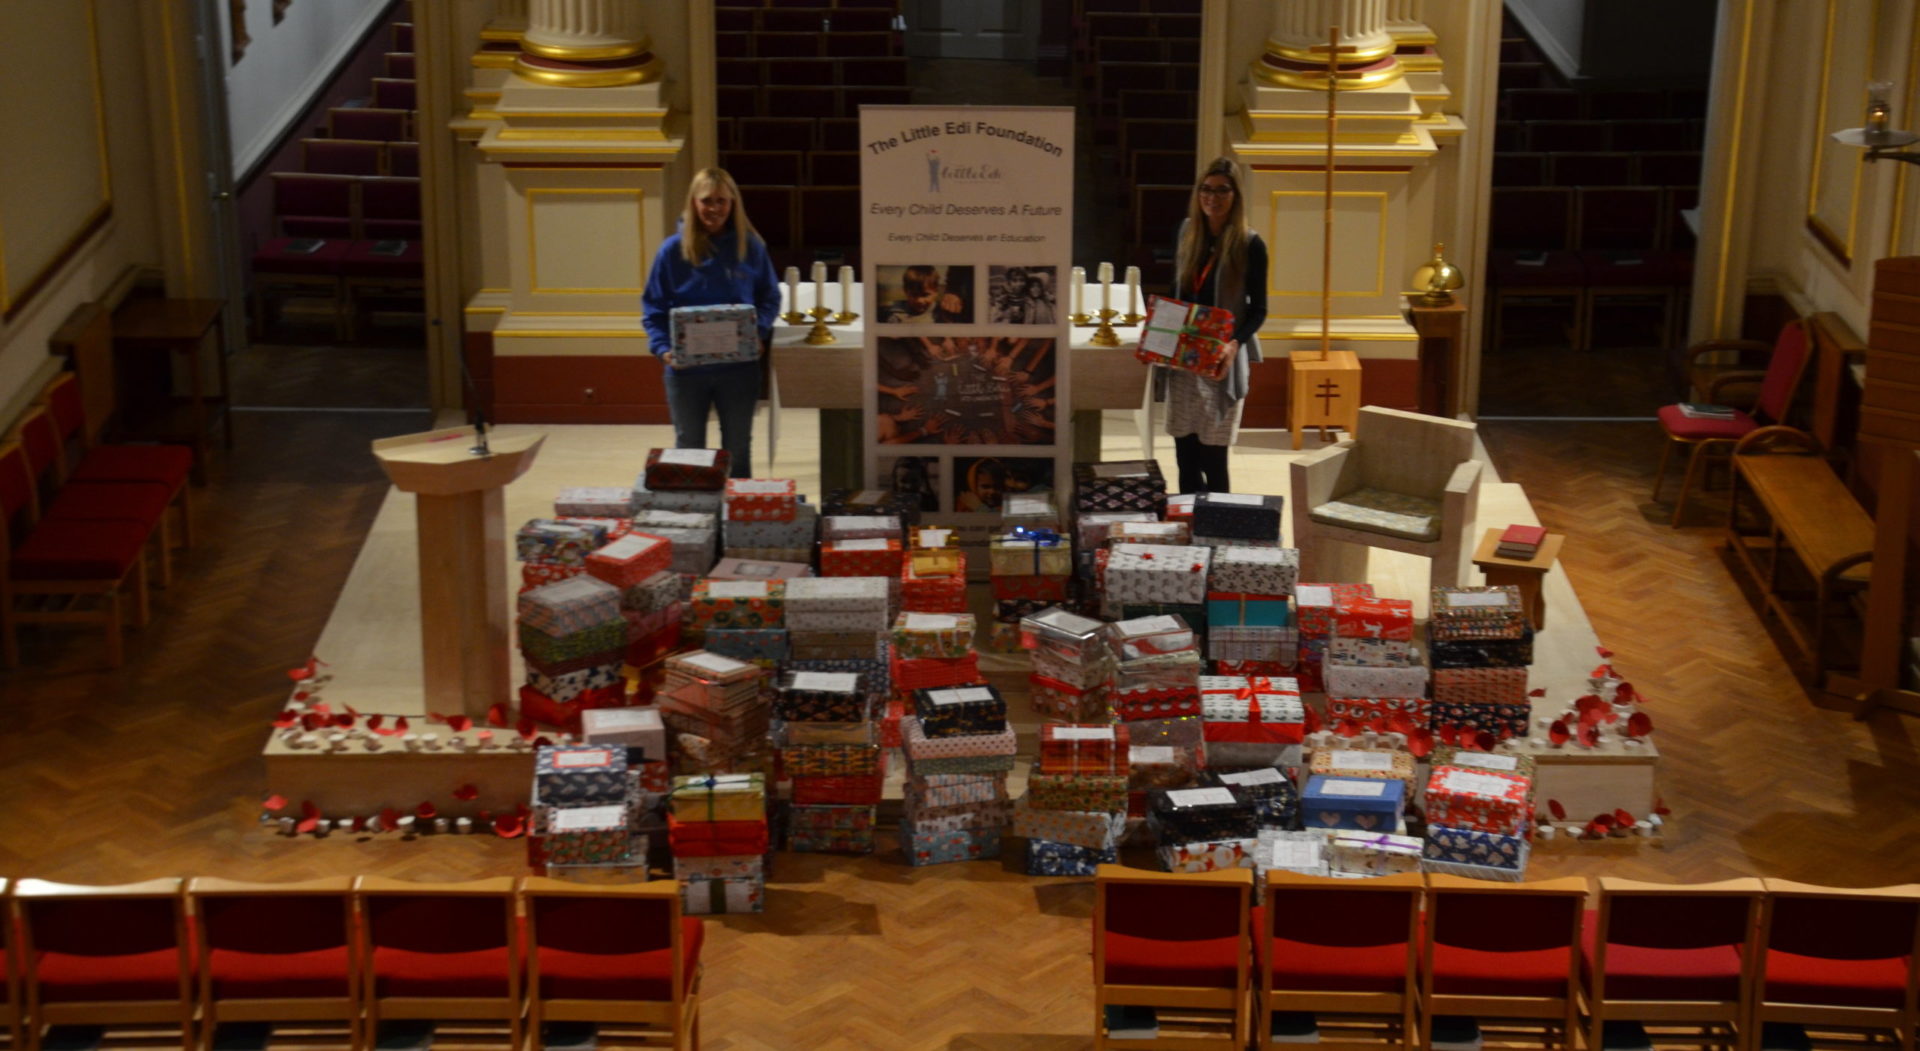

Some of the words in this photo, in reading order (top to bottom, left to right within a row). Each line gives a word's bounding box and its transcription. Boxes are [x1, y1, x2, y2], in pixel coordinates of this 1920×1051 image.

[868, 136, 898, 155] The
[901, 125, 941, 143] Little
[945, 122, 971, 135] Edi
[976, 122, 1064, 157] Foundation
[870, 203, 904, 217] Every
[908, 204, 942, 215] Child
[946, 204, 1006, 215] Deserves
[1008, 205, 1017, 215] A
[1021, 205, 1062, 215] Future
[888, 233, 912, 243] Every
[915, 233, 939, 242] Child
[942, 233, 983, 242] Deserves
[1001, 234, 1045, 243] Education
